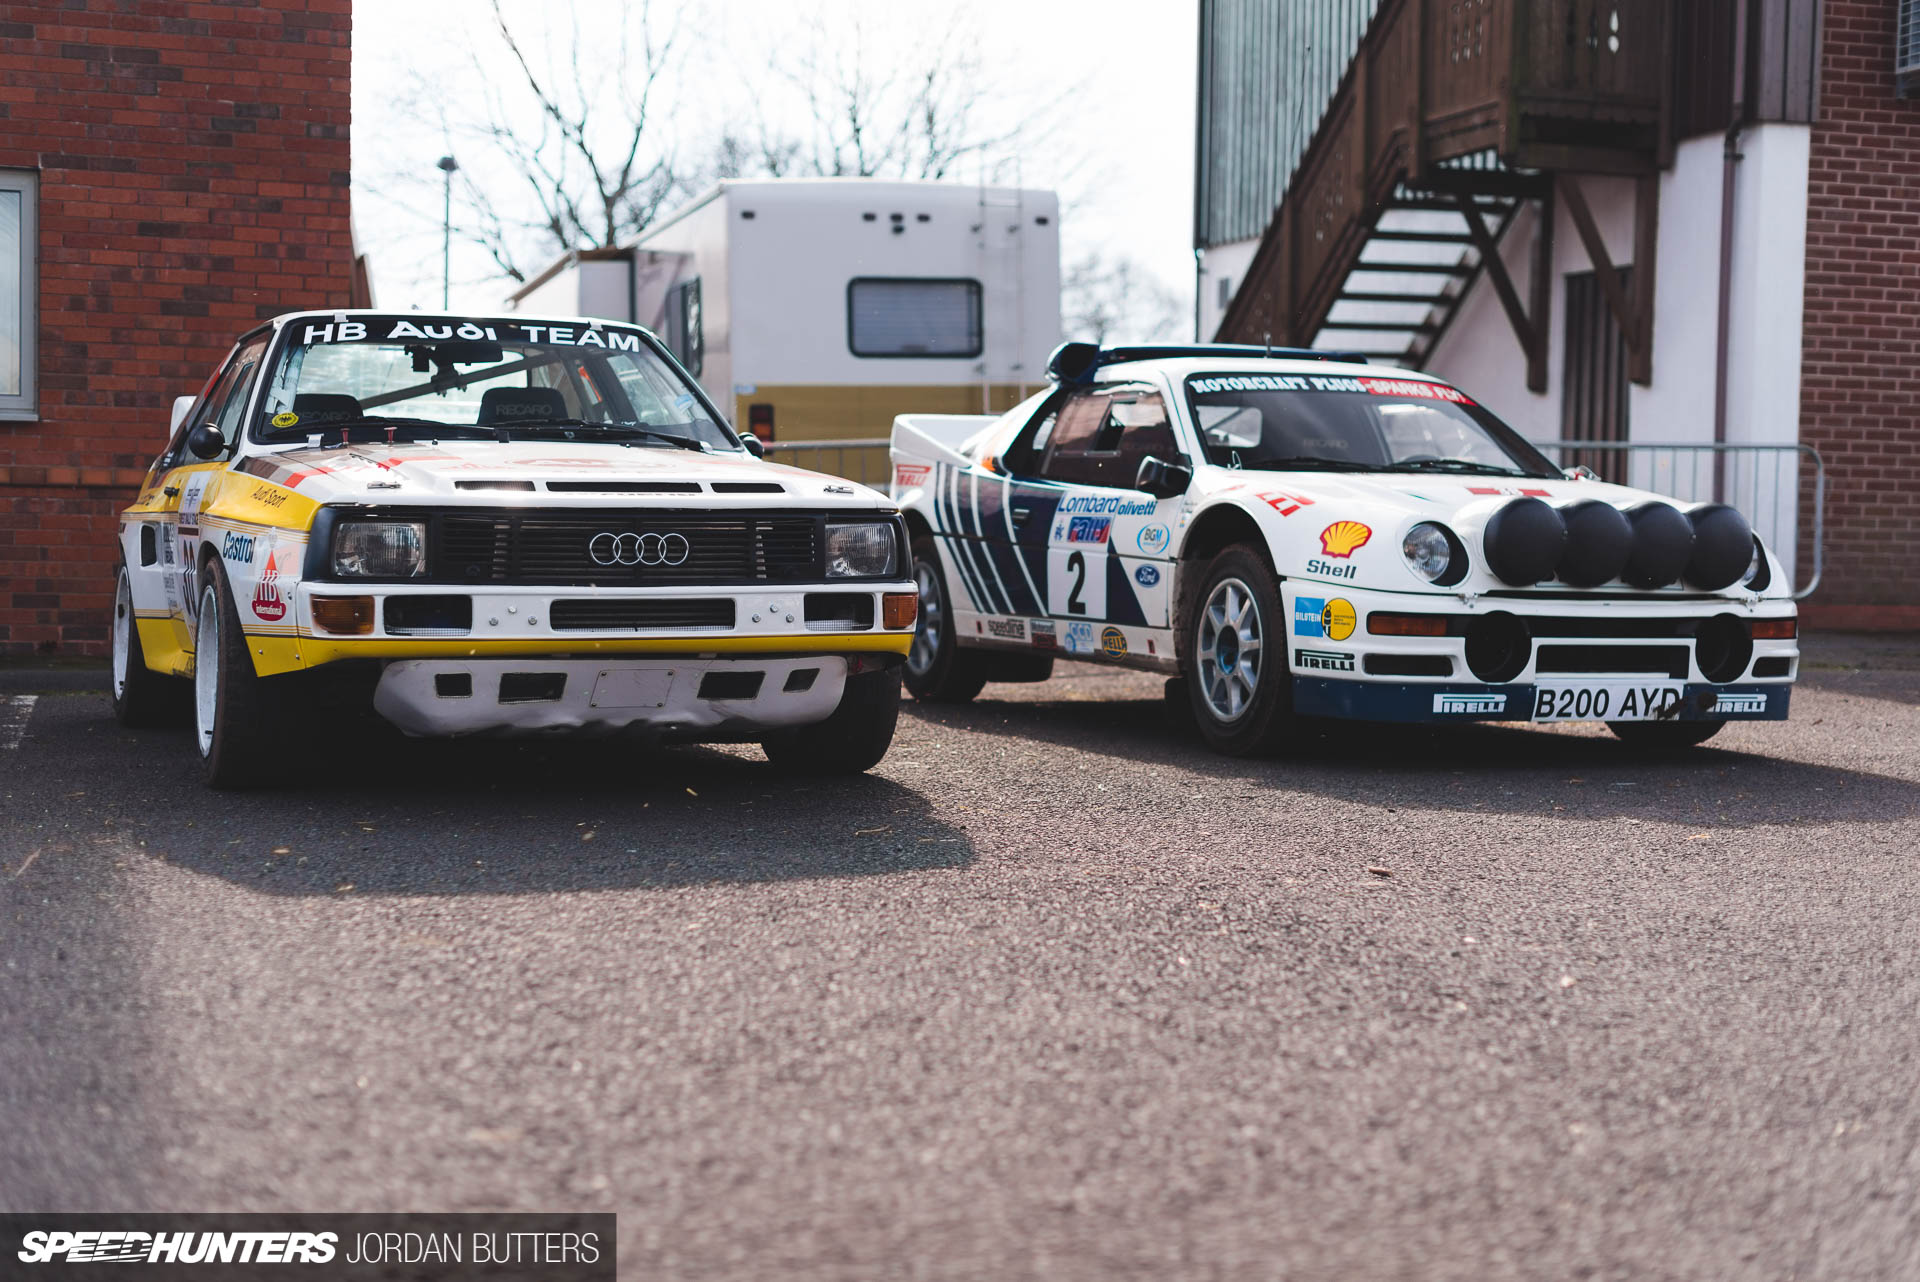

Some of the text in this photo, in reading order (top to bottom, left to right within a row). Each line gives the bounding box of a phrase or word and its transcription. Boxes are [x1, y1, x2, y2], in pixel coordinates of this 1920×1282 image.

[302, 322, 368, 345] HB
[520, 325, 640, 353] TEAM
[1190, 376, 1309, 393] MOTORCRAFT
[495, 403, 553, 416] RECARO
[251, 485, 288, 509] Audi Sport
[1057, 494, 1120, 513] Lombard
[1117, 500, 1158, 516] olivetti
[1143, 528, 1163, 541] BGM
[223, 530, 256, 564] Castrol
[1139, 566, 1156, 583] Ford
[1306, 558, 1357, 579] Shell
[1067, 550, 1086, 615] 2
[255, 603, 283, 617] international
[1295, 611, 1321, 623] BILSTEIN
[1103, 636, 1127, 651] HELLA
[1295, 648, 1355, 672] PIRELLI
[1433, 693, 1507, 713] PIRELLI
[1535, 688, 1680, 717] B200 AYD
